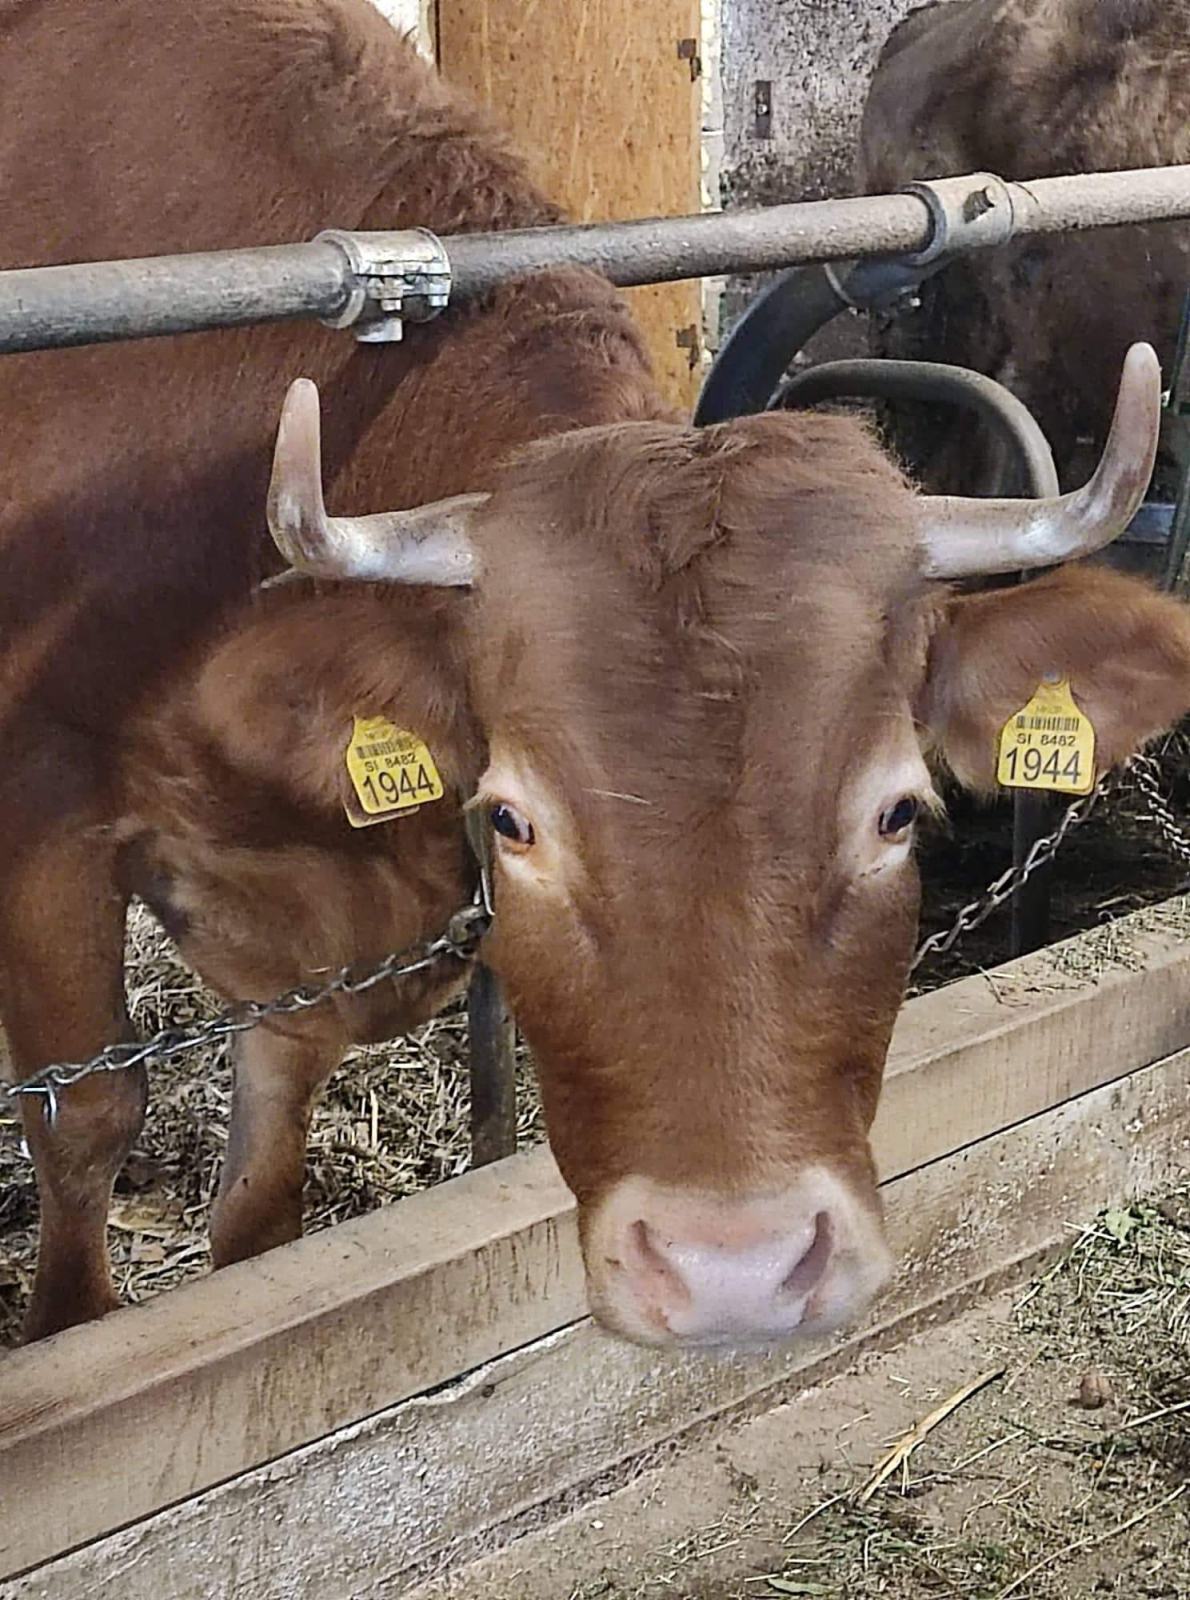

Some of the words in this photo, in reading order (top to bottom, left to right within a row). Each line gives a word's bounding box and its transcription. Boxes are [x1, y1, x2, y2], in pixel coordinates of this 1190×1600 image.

[1016, 733, 1032, 745] SI
[364, 760, 379, 773] SI
[1006, 747, 1083, 785] 1944
[363, 763, 435, 807] 1944
